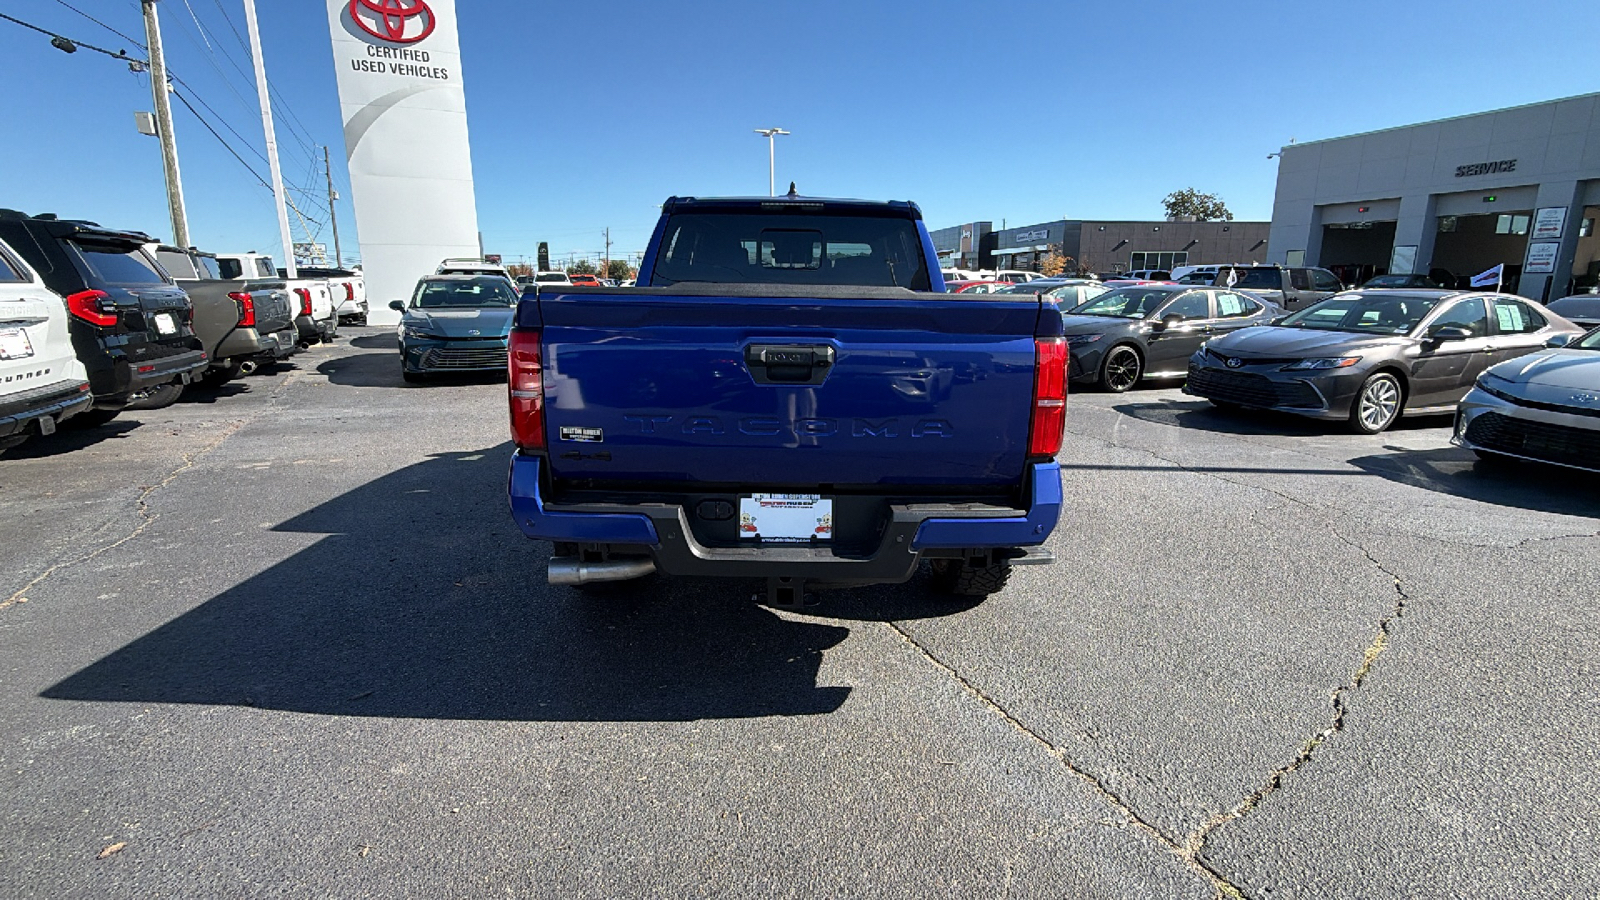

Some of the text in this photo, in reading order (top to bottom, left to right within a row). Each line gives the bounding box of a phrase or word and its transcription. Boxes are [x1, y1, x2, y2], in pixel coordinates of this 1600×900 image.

[367, 45, 430, 62] CERTIFIED
[351, 59, 448, 80] USED VEHICLES
[1455, 159, 1517, 177] SERVICE
[624, 415, 954, 438] TACOMA
